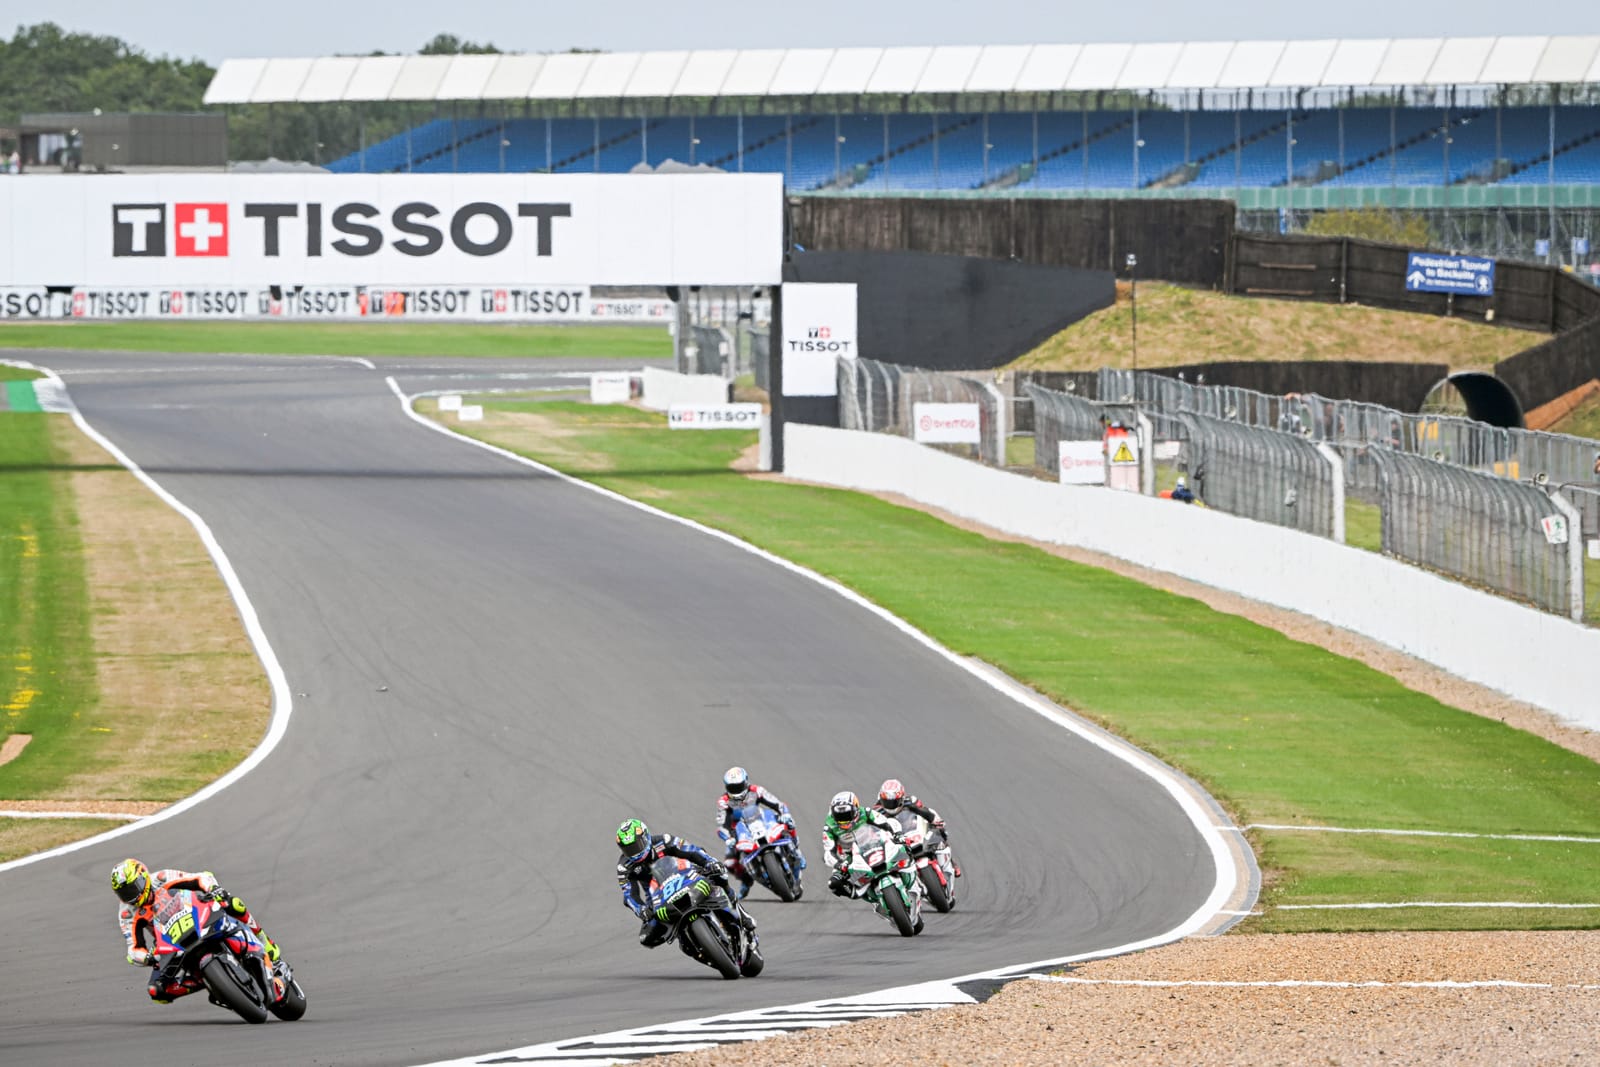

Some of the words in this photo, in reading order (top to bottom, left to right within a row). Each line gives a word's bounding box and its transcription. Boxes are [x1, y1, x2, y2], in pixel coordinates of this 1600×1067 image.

[244, 202, 572, 257] TISSOT
[0, 292, 53, 316] SOT
[88, 291, 149, 315] TISSOT
[186, 291, 248, 314] TISSOT
[285, 291, 349, 314] TISSOT
[511, 290, 583, 313] TISSOT
[789, 340, 851, 352] TISSOT
[699, 411, 757, 422] TISSOT
[168, 912, 195, 945] 36
